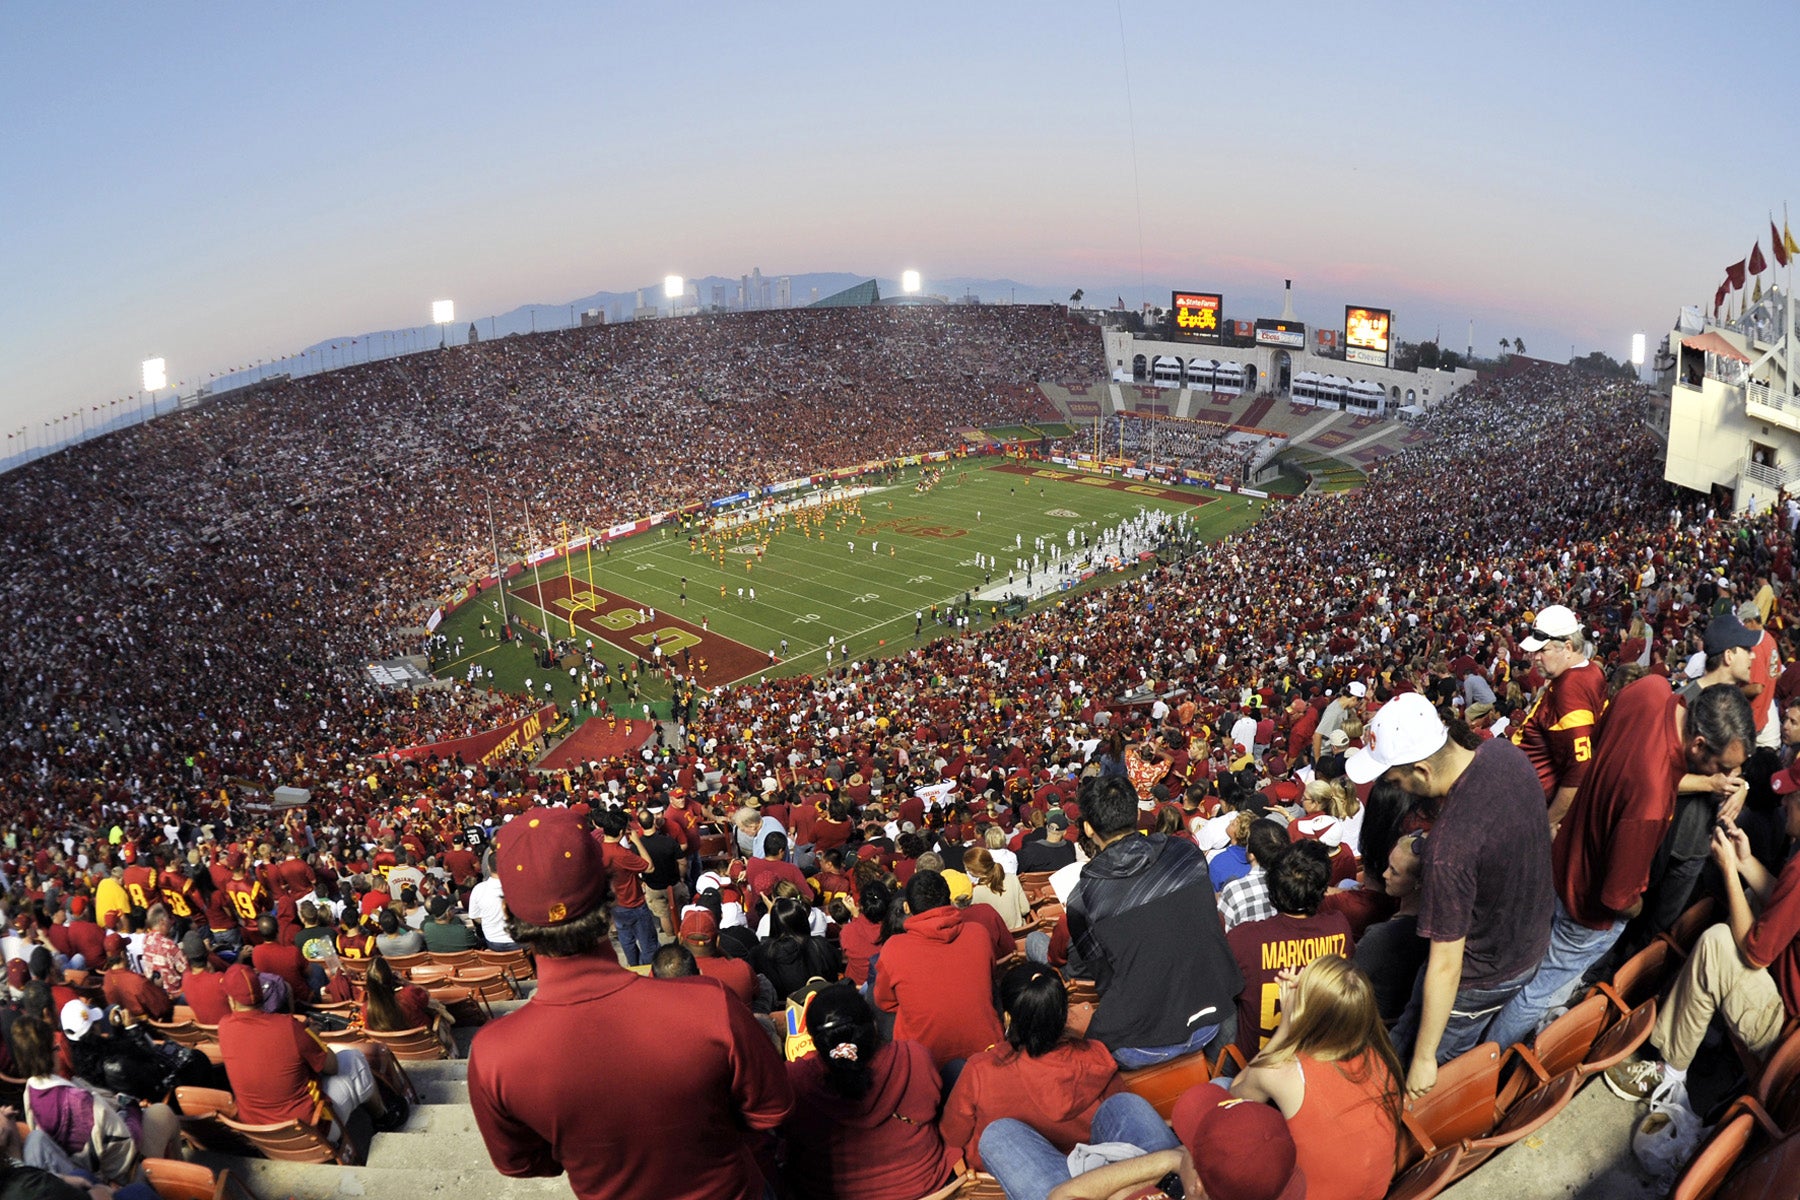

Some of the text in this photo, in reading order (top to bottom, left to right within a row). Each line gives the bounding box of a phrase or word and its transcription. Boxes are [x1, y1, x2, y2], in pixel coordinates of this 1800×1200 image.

[1358, 352, 1386, 362] Chevron
[523, 712, 541, 741] ON
[467, 834, 481, 845] 20
[227, 890, 257, 920] 19
[1261, 933, 1347, 970] MARKOWITZ
[1638, 1082, 1648, 1092] N
